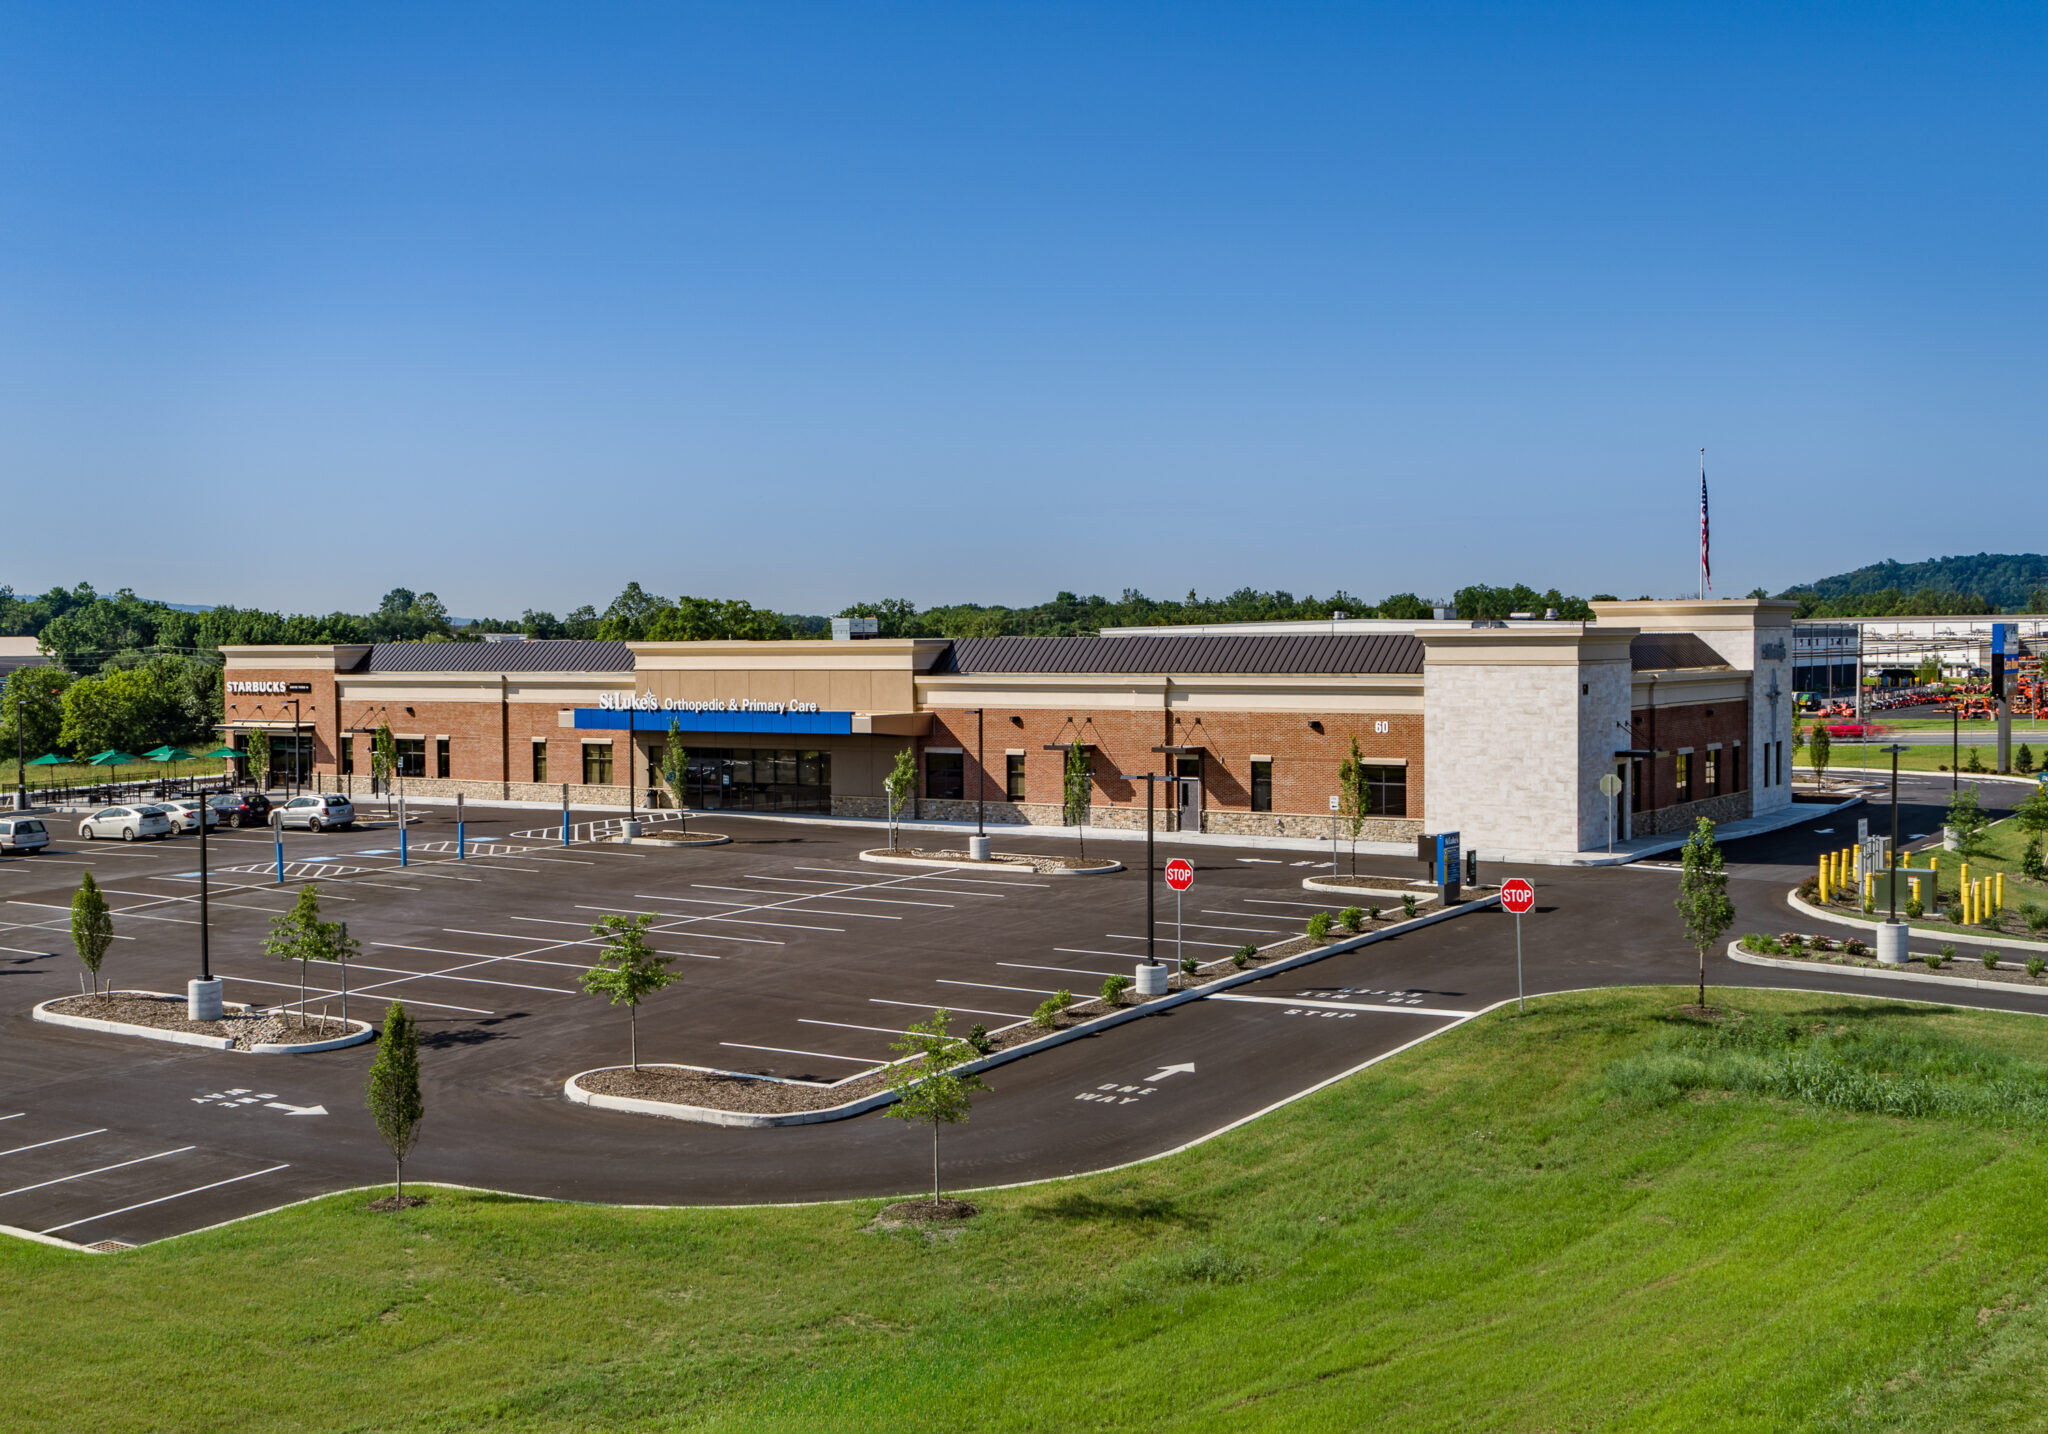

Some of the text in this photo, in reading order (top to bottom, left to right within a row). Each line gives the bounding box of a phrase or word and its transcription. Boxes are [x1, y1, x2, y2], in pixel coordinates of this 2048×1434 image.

[226, 681, 287, 693] STARBUCKS
[664, 697, 725, 713] Orthopedic
[729, 698, 738, 711] &
[742, 698, 785, 714] Primary
[790, 698, 817, 712] Care
[1375, 721, 1388, 733] 60
[1168, 868, 1191, 881] STOP
[1504, 889, 1531, 902] STOP
[1283, 1008, 1357, 1019] STOP
[1096, 1083, 1158, 1096] ONE
[1074, 1092, 1140, 1104] WAY
